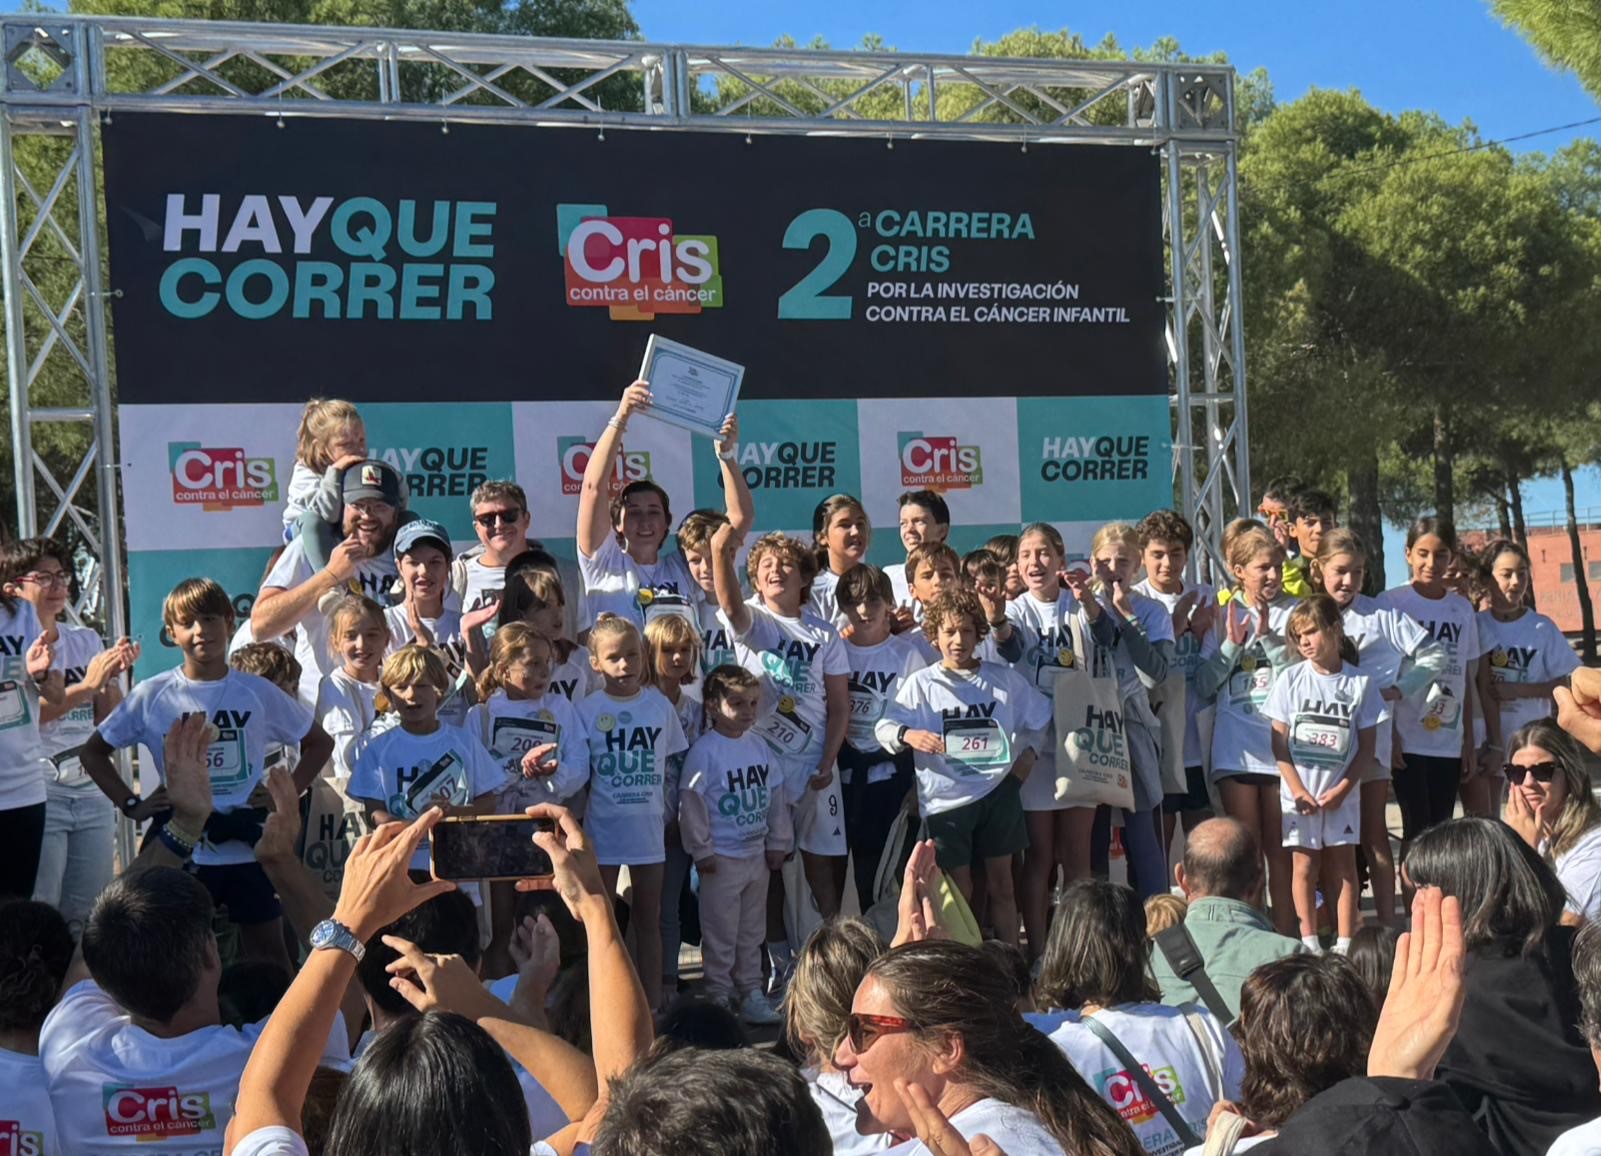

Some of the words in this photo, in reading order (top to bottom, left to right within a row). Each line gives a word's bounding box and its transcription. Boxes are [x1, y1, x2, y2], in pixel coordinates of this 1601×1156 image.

[875, 209, 1035, 240] CARRERA
[568, 219, 713, 284] Cris
[870, 245, 951, 273] CRIS
[158, 257, 496, 321] CORRER
[570, 286, 629, 301] contra
[633, 285, 649, 301] el
[653, 285, 716, 302] cáncer
[867, 282, 907, 299] POR
[910, 283, 935, 299] LA
[937, 281, 1080, 300] INVESTIGACIÓN
[866, 305, 947, 322] CONTRA
[950, 306, 970, 322] EL
[974, 304, 1051, 323] CÁNCER
[1053, 307, 1131, 323] INFANTIL
[175, 450, 273, 489] Cris
[563, 444, 648, 481] Cis
[902, 439, 979, 474] Cris
[903, 475, 934, 484] contra
[936, 474, 945, 484] el
[1041, 459, 1149, 482] CORRER
[176, 490, 217, 501] contra
[218, 489, 229, 500] el
[232, 488, 273, 500] cáncer
[0, 635, 25, 656] AY
[1085, 705, 1123, 733] HAY
[605, 727, 662, 751] HAY
[768, 721, 795, 744] 210
[962, 737, 989, 750] 261
[1074, 727, 1124, 757] QUE
[1309, 732, 1338, 748] 383
[596, 749, 657, 777] QUE
[611, 774, 662, 788] CORRER
[727, 764, 769, 793] HAY
[718, 788, 767, 816] QUE
[828, 795, 838, 816] 9
[319, 812, 362, 840] HA
[107, 1090, 208, 1123] Cris
[110, 1121, 151, 1134] contra
[153, 1121, 166, 1131] el
